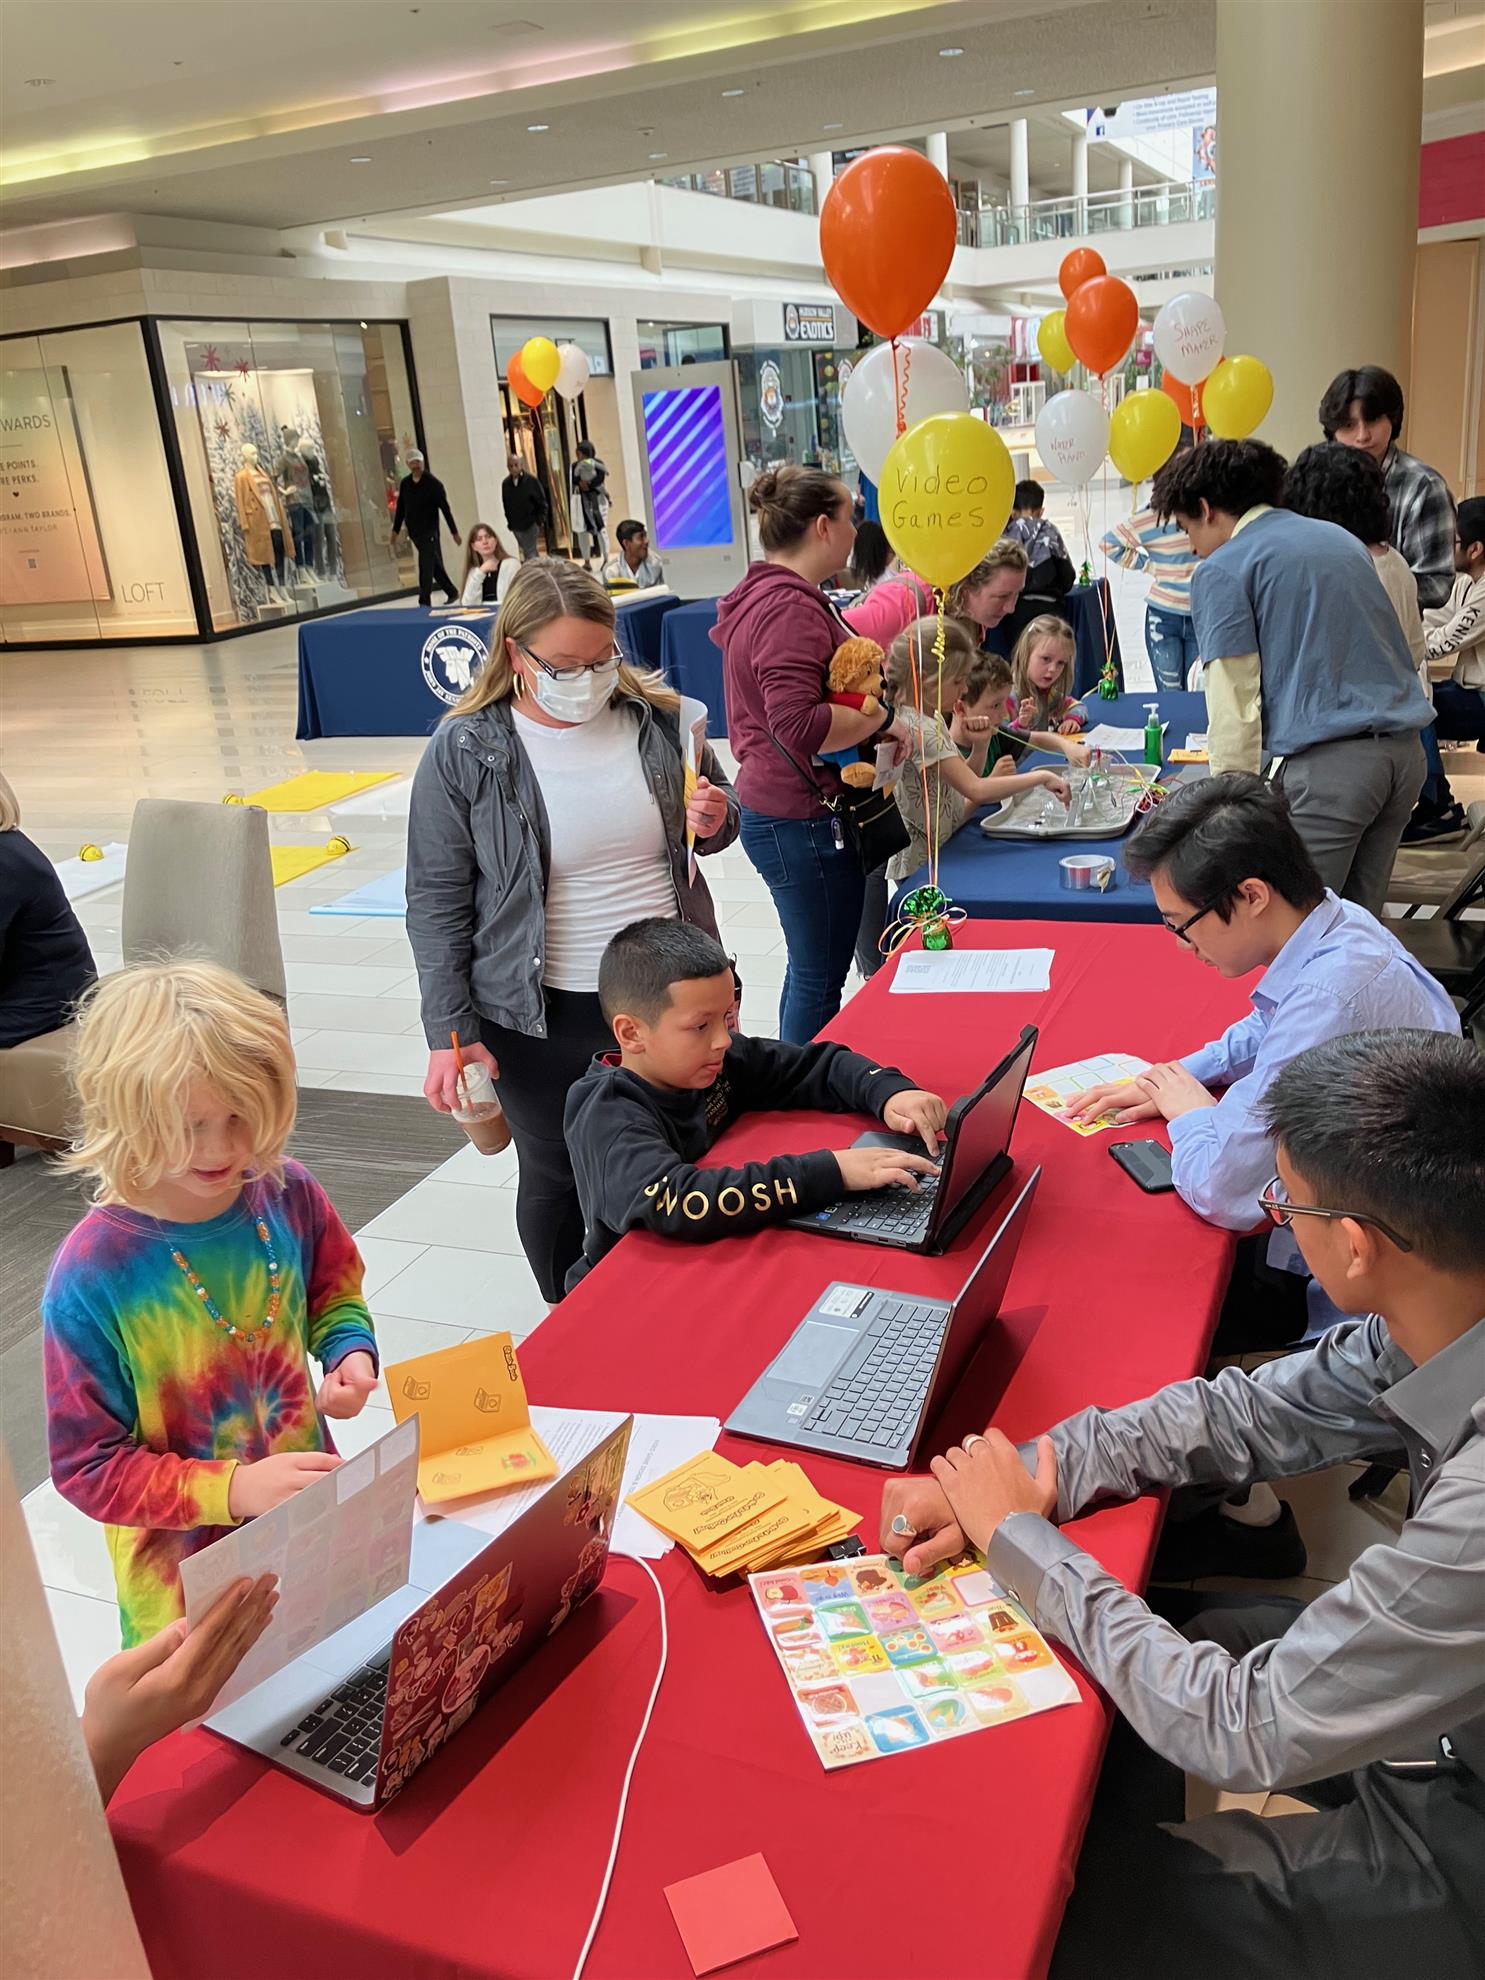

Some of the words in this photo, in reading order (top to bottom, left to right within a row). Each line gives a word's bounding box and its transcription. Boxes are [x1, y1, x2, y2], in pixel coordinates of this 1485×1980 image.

[896, 464, 989, 495] Video
[892, 500, 985, 530] Games
[120, 581, 166, 603] LOFT
